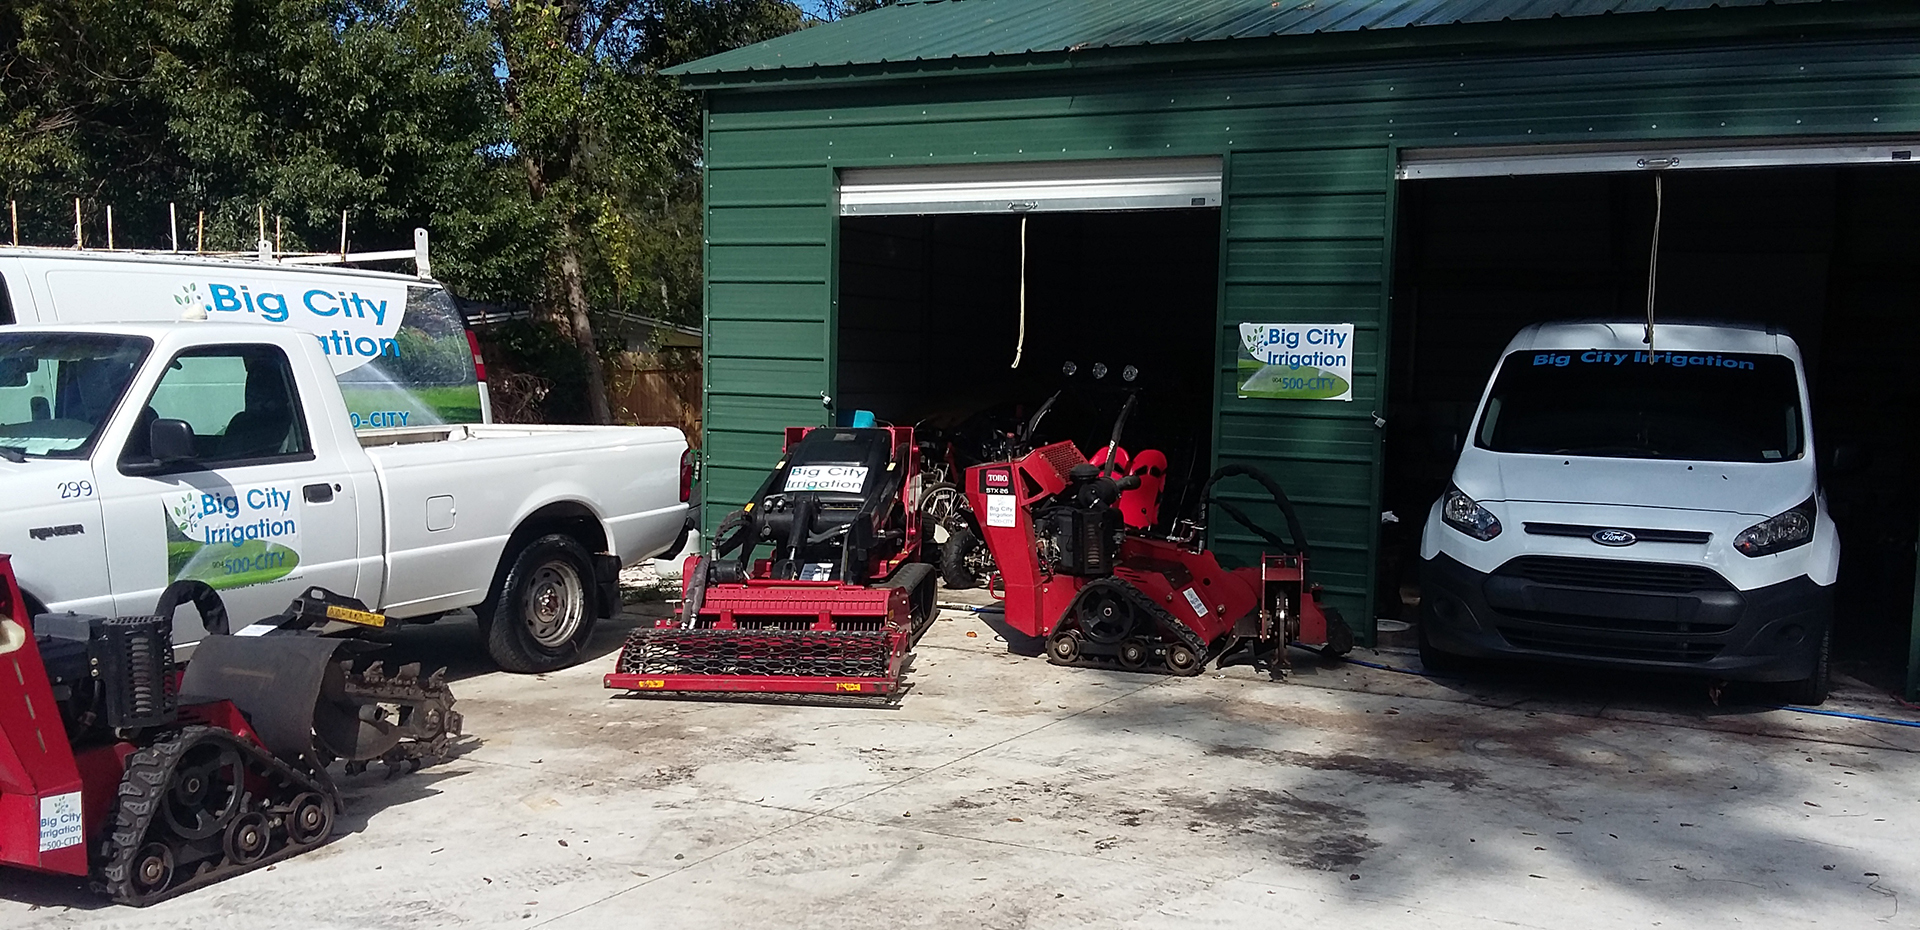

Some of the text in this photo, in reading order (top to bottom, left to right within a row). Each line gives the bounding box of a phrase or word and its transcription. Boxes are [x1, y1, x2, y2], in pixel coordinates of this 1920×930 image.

[208, 283, 388, 326] Big City
[1269, 328, 1348, 349] Big City
[1267, 351, 1347, 371] Irrigation
[1533, 351, 1755, 371] Big City Irrigation
[1282, 377, 1336, 391] 500-CITY
[791, 467, 867, 479] Big City
[987, 474, 1009, 482] TORO
[57, 480, 93, 499] 299
[786, 479, 862, 490] Irrigation
[201, 487, 291, 519] Big City
[205, 518, 296, 548] Irrigation
[224, 551, 286, 575] 500-CITY
[40, 811, 82, 828] Big City
[40, 824, 82, 839] Irrigation
